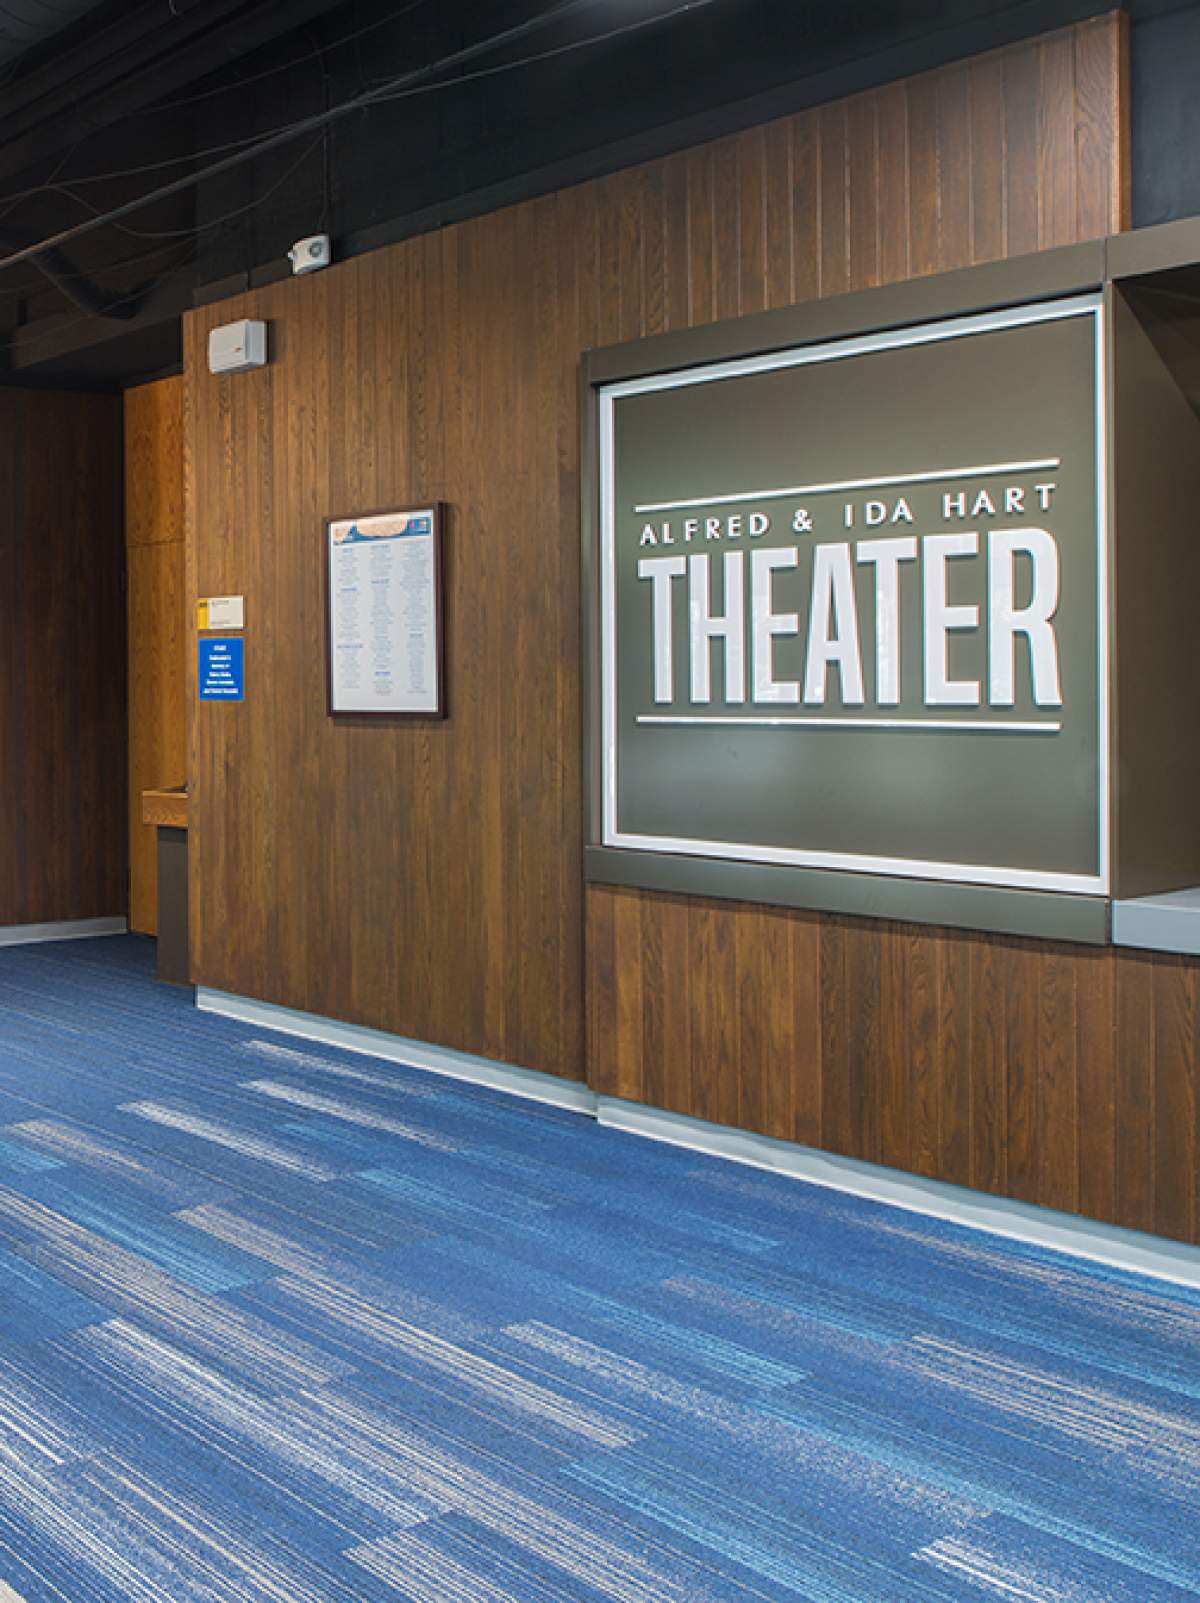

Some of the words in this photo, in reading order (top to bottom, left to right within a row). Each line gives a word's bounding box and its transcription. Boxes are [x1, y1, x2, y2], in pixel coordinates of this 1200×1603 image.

[639, 511, 770, 546] ALFRED
[792, 508, 813, 533] &
[844, 498, 914, 528] IDA
[942, 483, 1057, 519] HART
[637, 527, 1063, 707] THEATER
